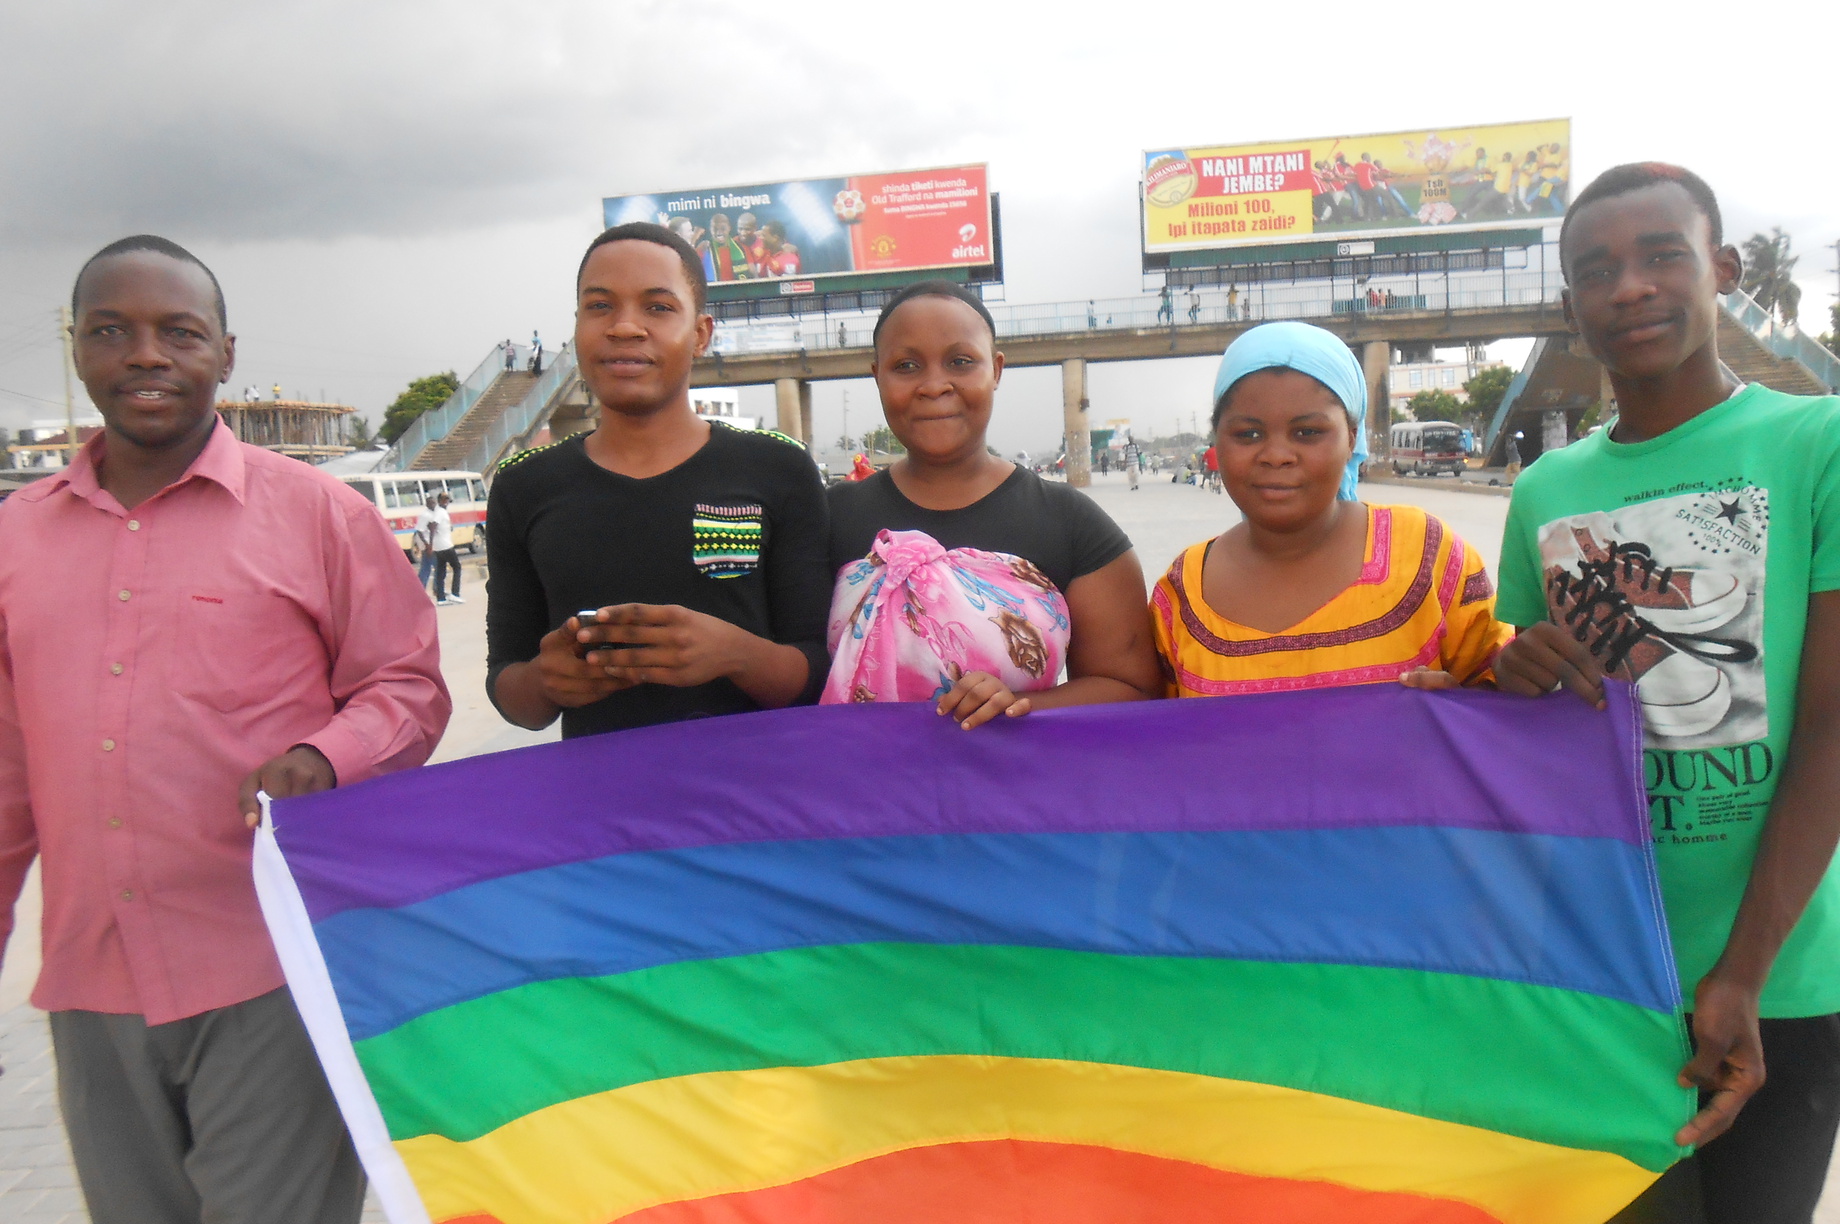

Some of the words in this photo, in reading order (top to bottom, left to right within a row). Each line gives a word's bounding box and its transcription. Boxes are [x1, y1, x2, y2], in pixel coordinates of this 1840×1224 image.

[1202, 158, 1243, 177] NANI
[1250, 153, 1304, 174] MTANI
[882, 183, 910, 193] shinda
[911, 180, 934, 191] tiketi
[935, 178, 967, 189] kwenda
[1223, 174, 1285, 194] JEMBE?
[668, 196, 701, 212] mimi
[704, 195, 716, 209] ni
[720, 193, 771, 210] bingwa
[871, 194, 887, 204] Old
[889, 192, 922, 203] Trafford
[923, 191, 934, 200] na
[935, 187, 978, 199] mamilioni
[1188, 200, 1238, 218] Milioni
[1243, 198, 1275, 215] 100,
[1168, 221, 1187, 238] Ipi
[1192, 219, 1246, 236] itapata
[1251, 215, 1296, 232] zaidi?
[952, 244, 985, 259] airtel
[1624, 488, 1665, 503] walkin
[1675, 509, 1762, 555] SATISFACTION
[1702, 533, 1723, 548] 100%
[1672, 833, 1727, 844] homme
